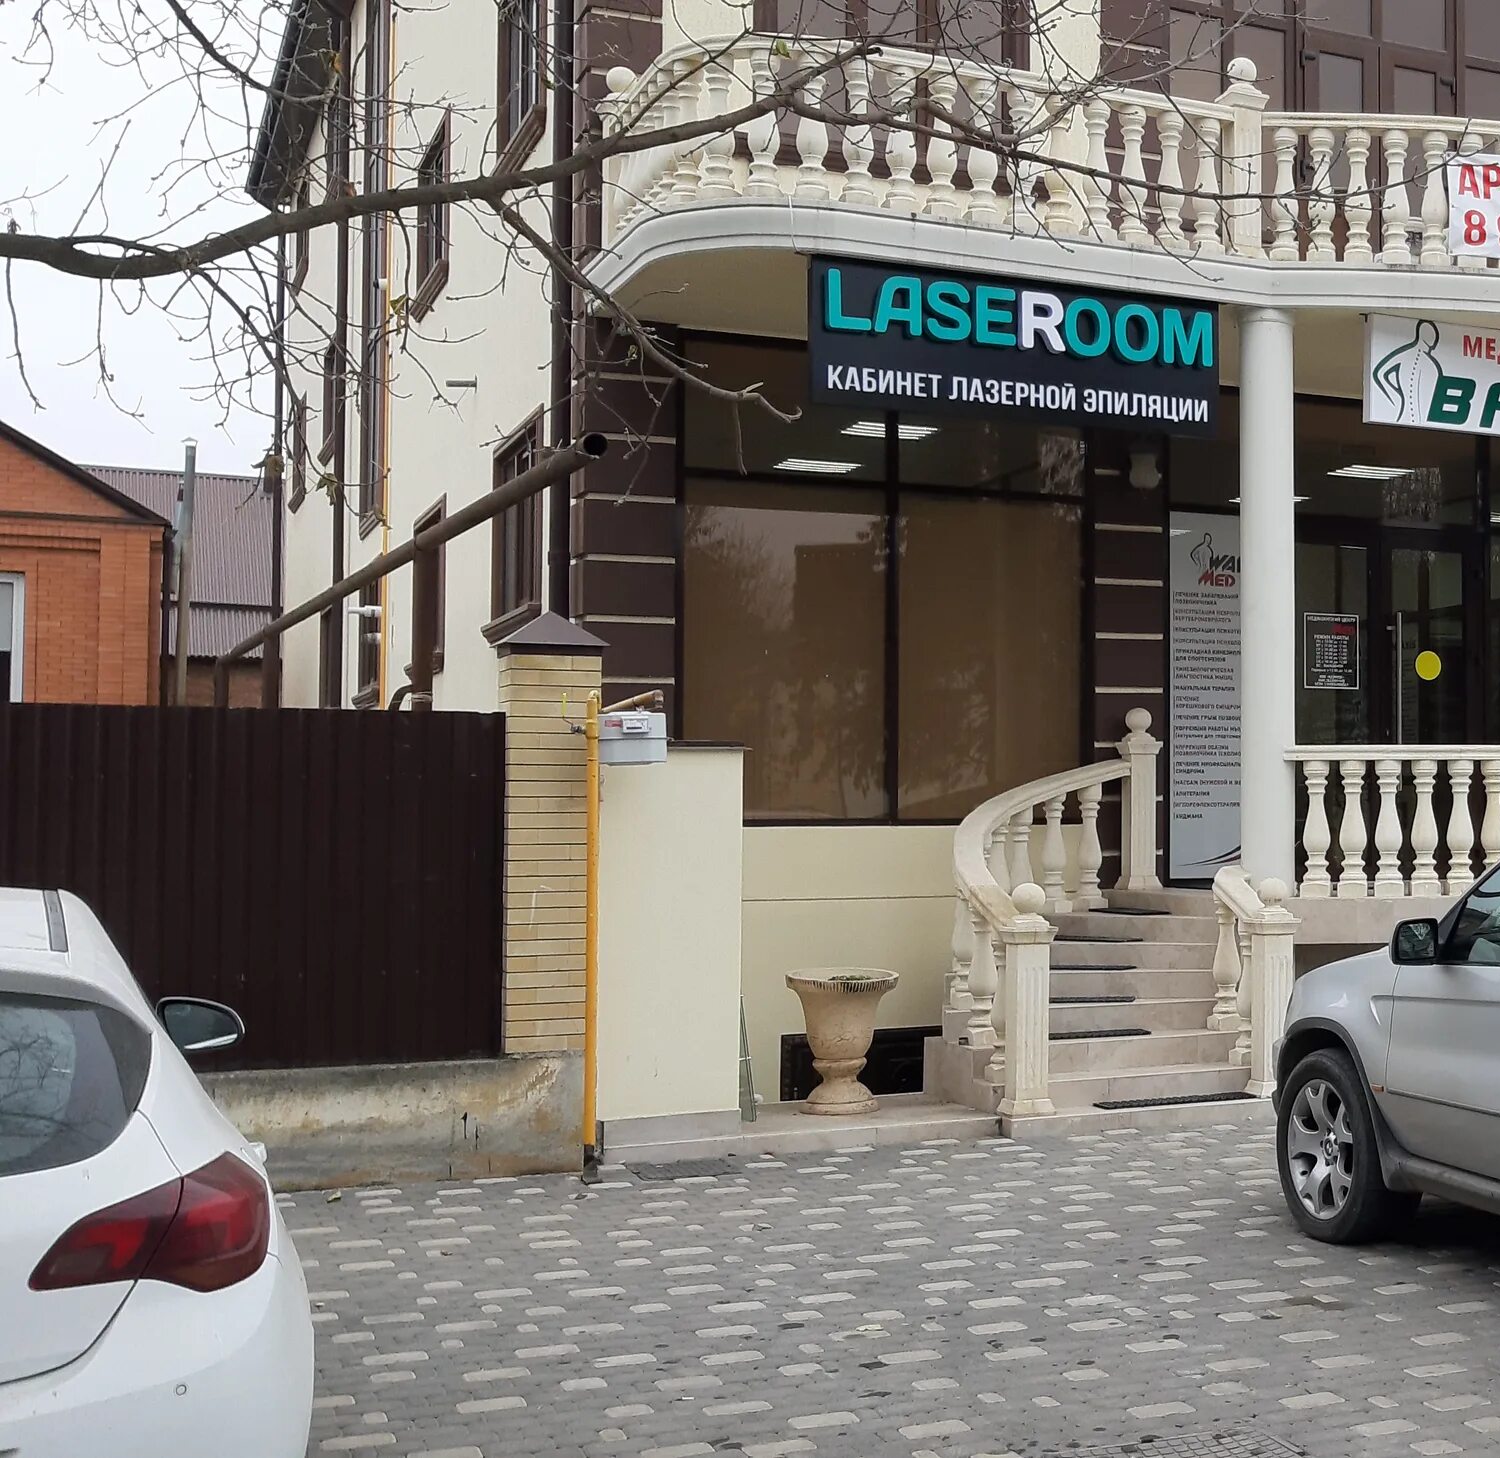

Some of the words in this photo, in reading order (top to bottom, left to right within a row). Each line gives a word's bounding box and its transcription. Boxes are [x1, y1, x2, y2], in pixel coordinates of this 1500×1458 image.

[1464, 209, 1486, 246] 8
[826, 268, 1213, 367] LASEROOM
[827, 365, 942, 399] КАБИНЕТ
[948, 376, 1076, 411] ЛАЗЕРНОЙ
[1083, 389, 1209, 423] ЭПИЛЯЦИИ
[1198, 568, 1235, 587] MED
